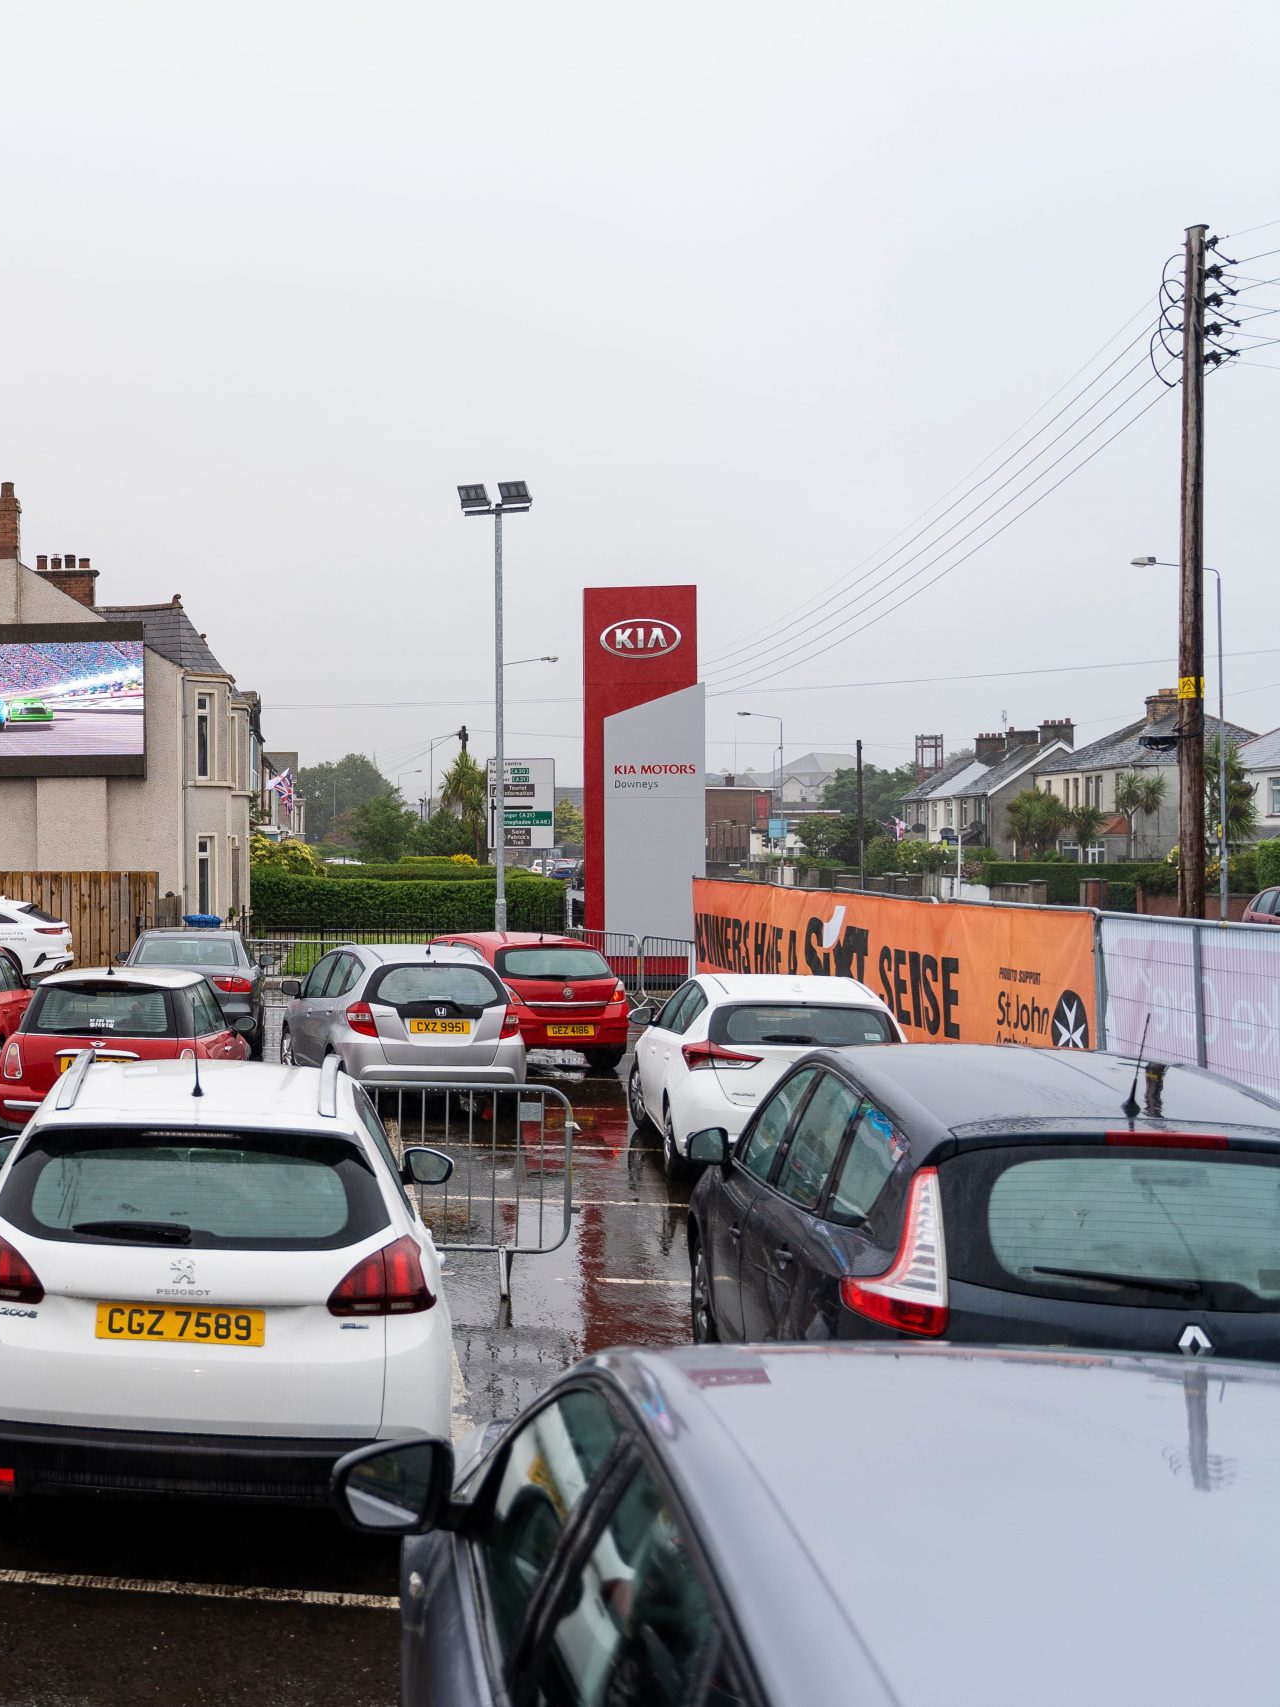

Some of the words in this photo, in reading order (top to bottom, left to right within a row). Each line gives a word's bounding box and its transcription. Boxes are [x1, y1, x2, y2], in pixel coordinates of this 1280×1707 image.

[614, 627, 668, 649] KIA
[614, 765, 637, 775] KIA
[640, 764, 696, 775] MOTORS
[614, 780, 659, 790] Downeys
[996, 991, 1012, 1028] St
[1013, 993, 1050, 1036] John
[417, 1021, 438, 1032] CXZ
[440, 1022, 464, 1033] 9951
[552, 1025, 569, 1035] GEZ
[571, 1026, 590, 1035] 4186
[156, 1288, 211, 1296] PEUGEOT
[0, 1307, 39, 1319] 2008
[108, 1307, 166, 1336] CGZ
[175, 1310, 252, 1341] 7589
